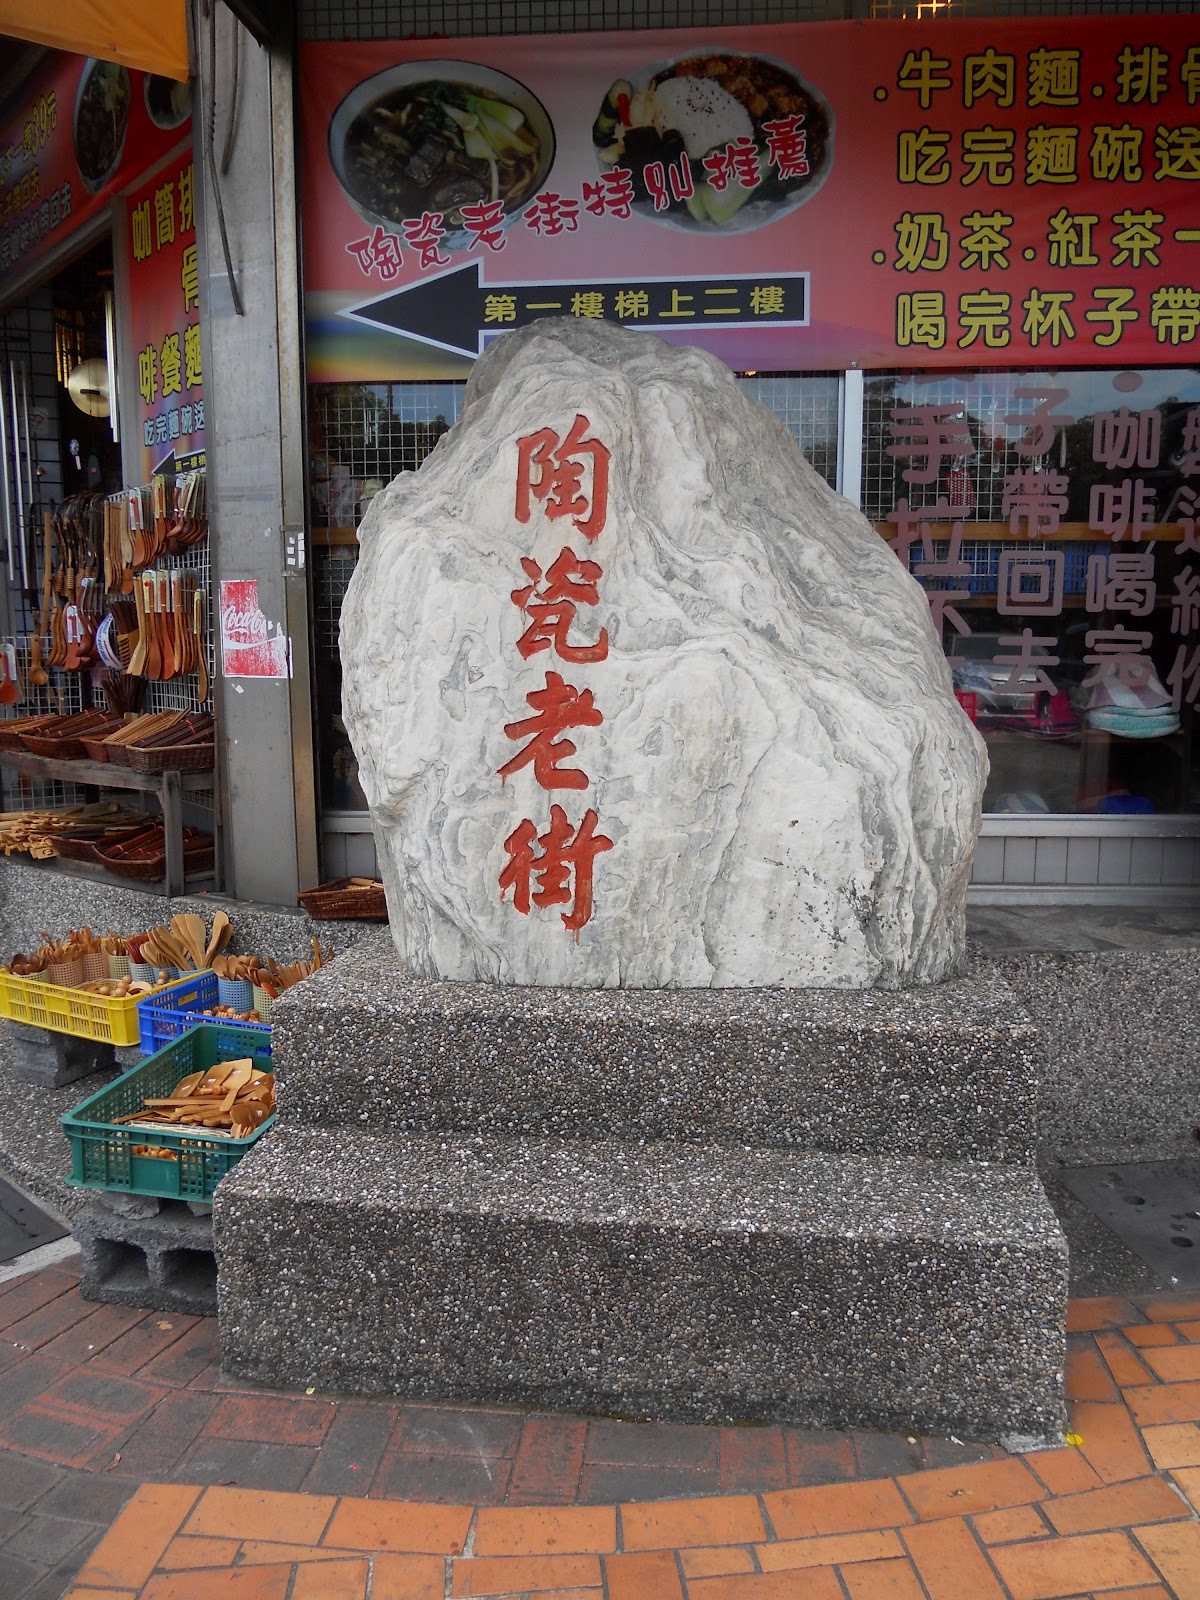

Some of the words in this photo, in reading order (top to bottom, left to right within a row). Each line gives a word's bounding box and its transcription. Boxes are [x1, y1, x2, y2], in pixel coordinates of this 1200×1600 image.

[346, 114, 812, 280] 陶瓷老街特別推薦
[483, 286, 786, 323] 第一樓梯上二樓
[896, 288, 1200, 348] 喝完杯子帶
[990, 372, 1075, 697] 子帶回去
[497, 413, 613, 932] 陶瓷老街
